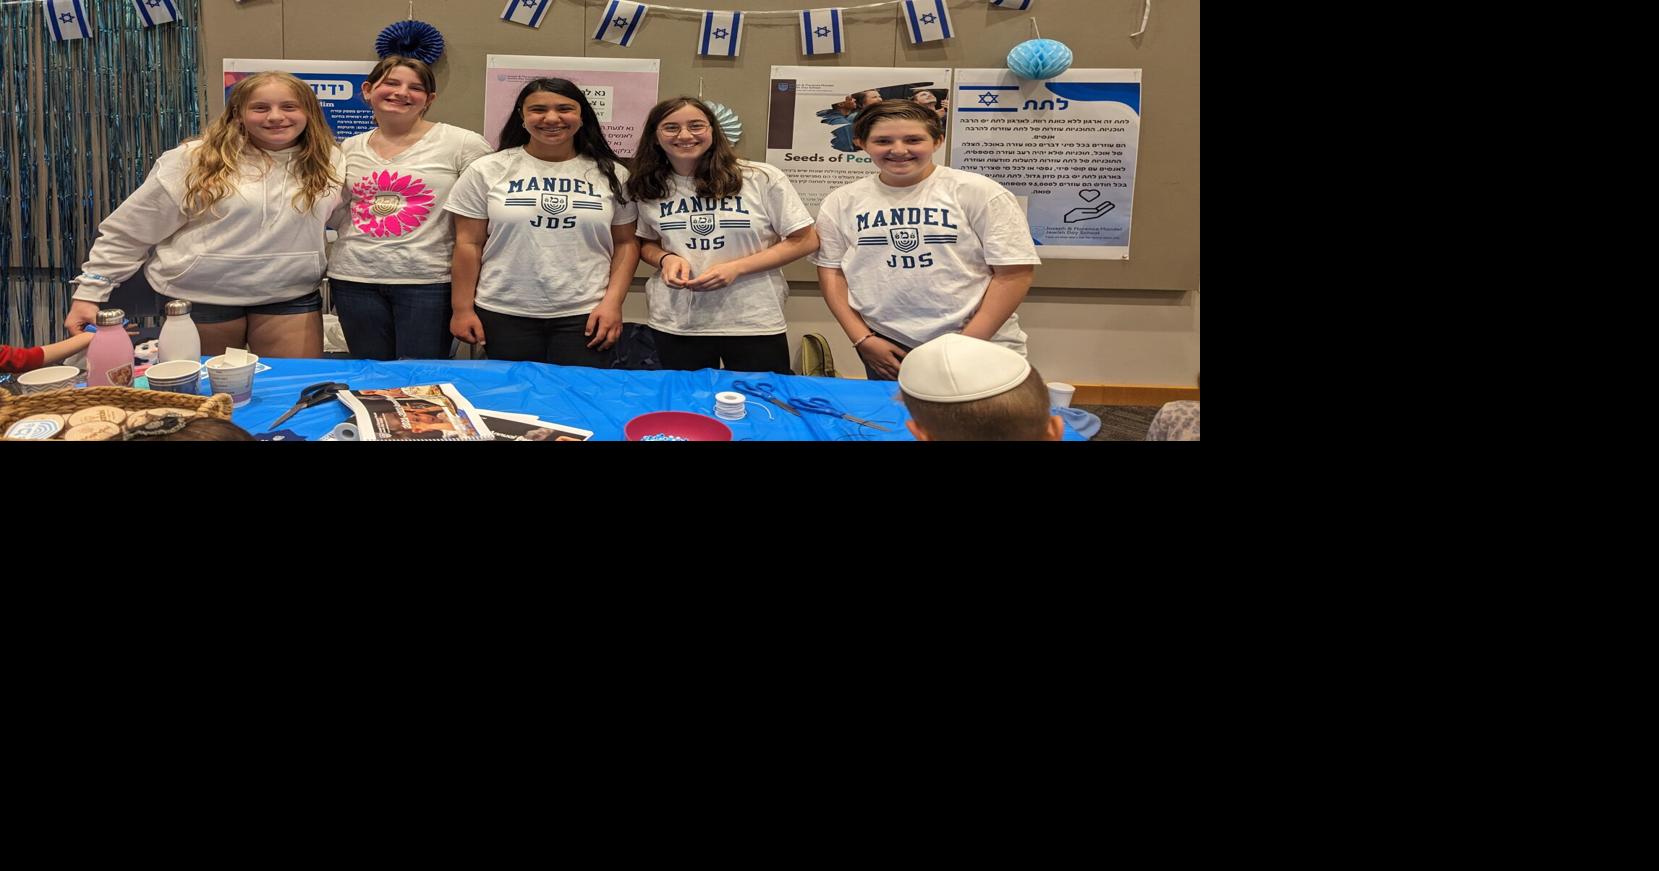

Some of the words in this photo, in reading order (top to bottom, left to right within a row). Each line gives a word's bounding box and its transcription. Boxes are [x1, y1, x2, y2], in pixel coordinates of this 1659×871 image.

[310, 84, 344, 95] ידיד
[1022, 98, 1069, 110] לתת
[784, 152, 825, 162] Seeds
[828, 153, 844, 163] of
[846, 154, 872, 163] Pea
[507, 176, 602, 198] MANDEL
[659, 196, 749, 218] MANDEL
[529, 215, 577, 229] JDS
[856, 207, 958, 232] MANDEL
[685, 235, 725, 251] JDS
[886, 252, 934, 269] JDS
